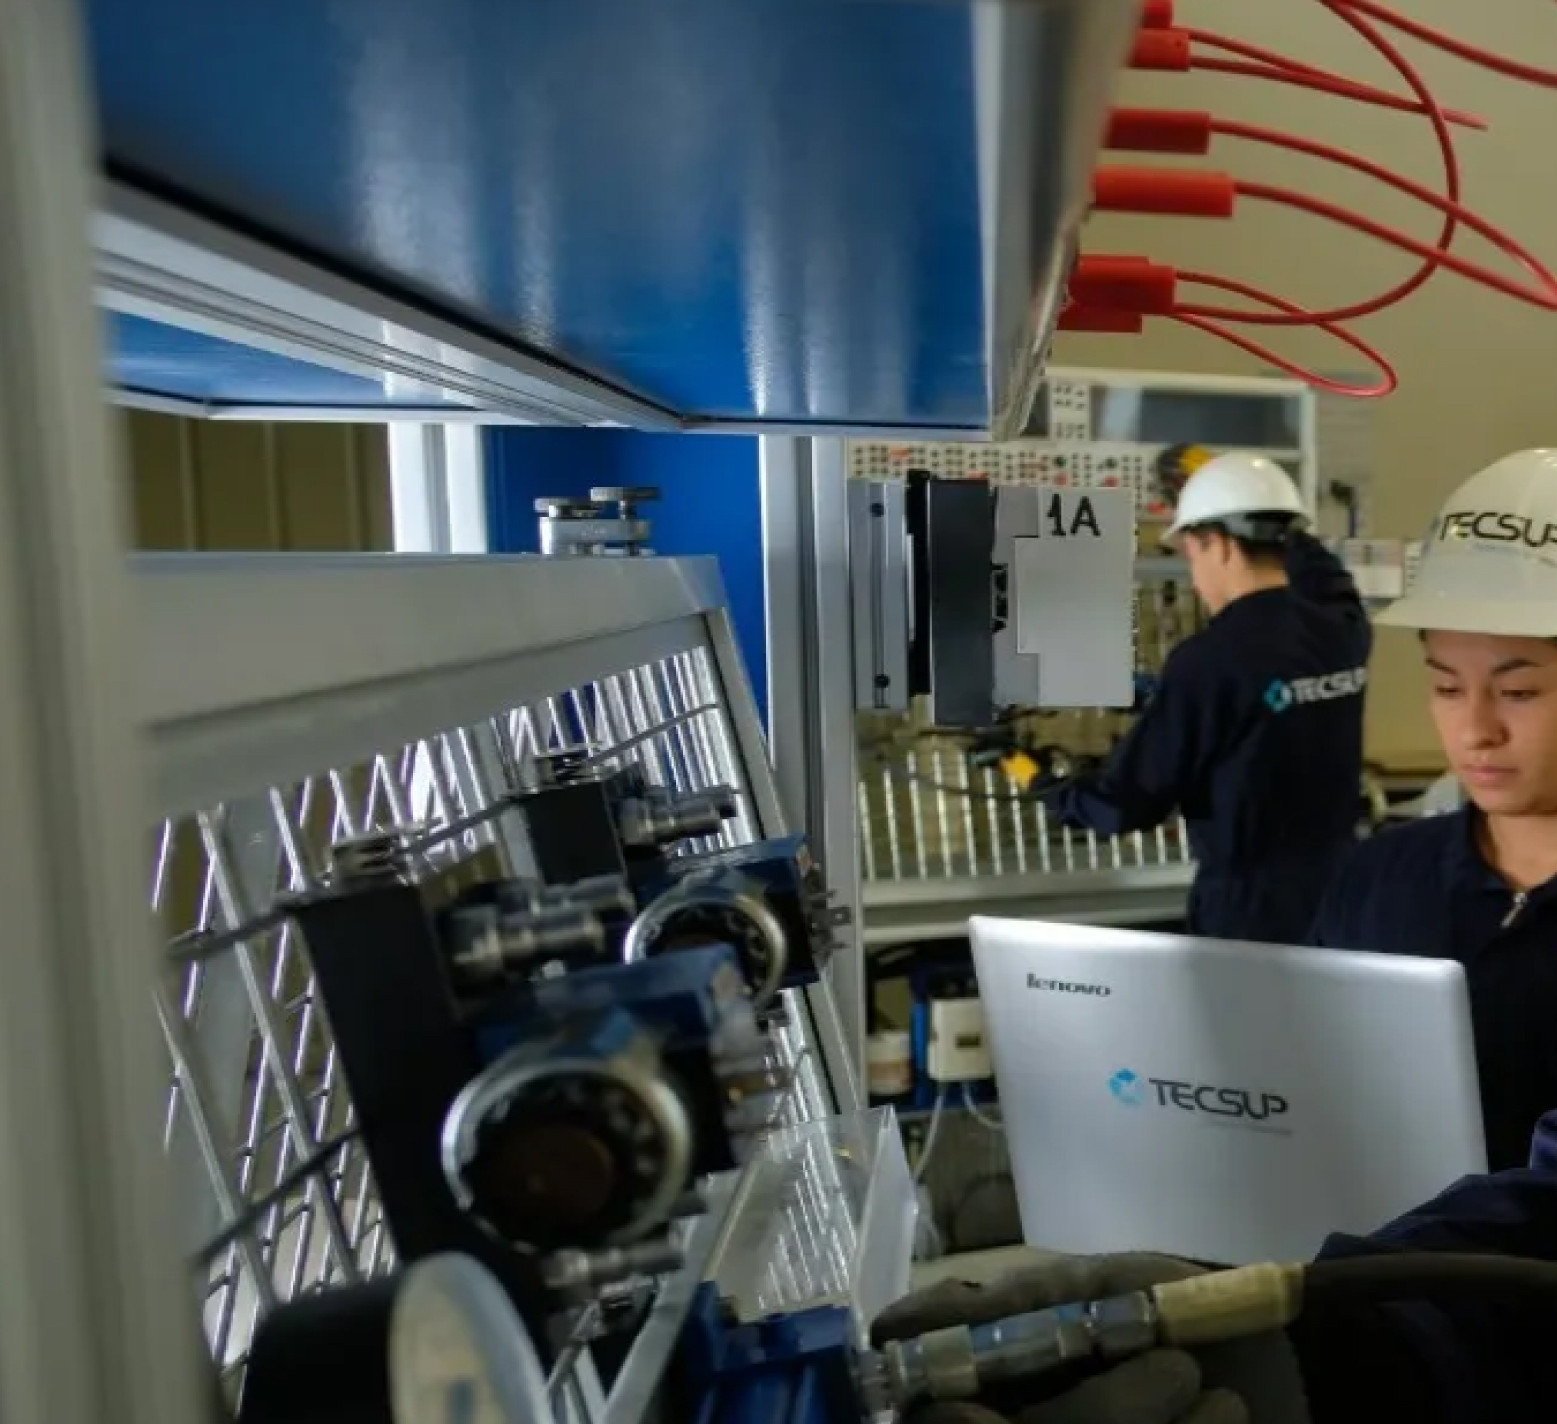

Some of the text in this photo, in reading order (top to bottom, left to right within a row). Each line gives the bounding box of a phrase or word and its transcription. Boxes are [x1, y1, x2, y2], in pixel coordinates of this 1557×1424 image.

[1047, 493, 1101, 536] 1A
[1026, 972, 1111, 998] lenovo
[1149, 1077, 1289, 1120] TECSUP
